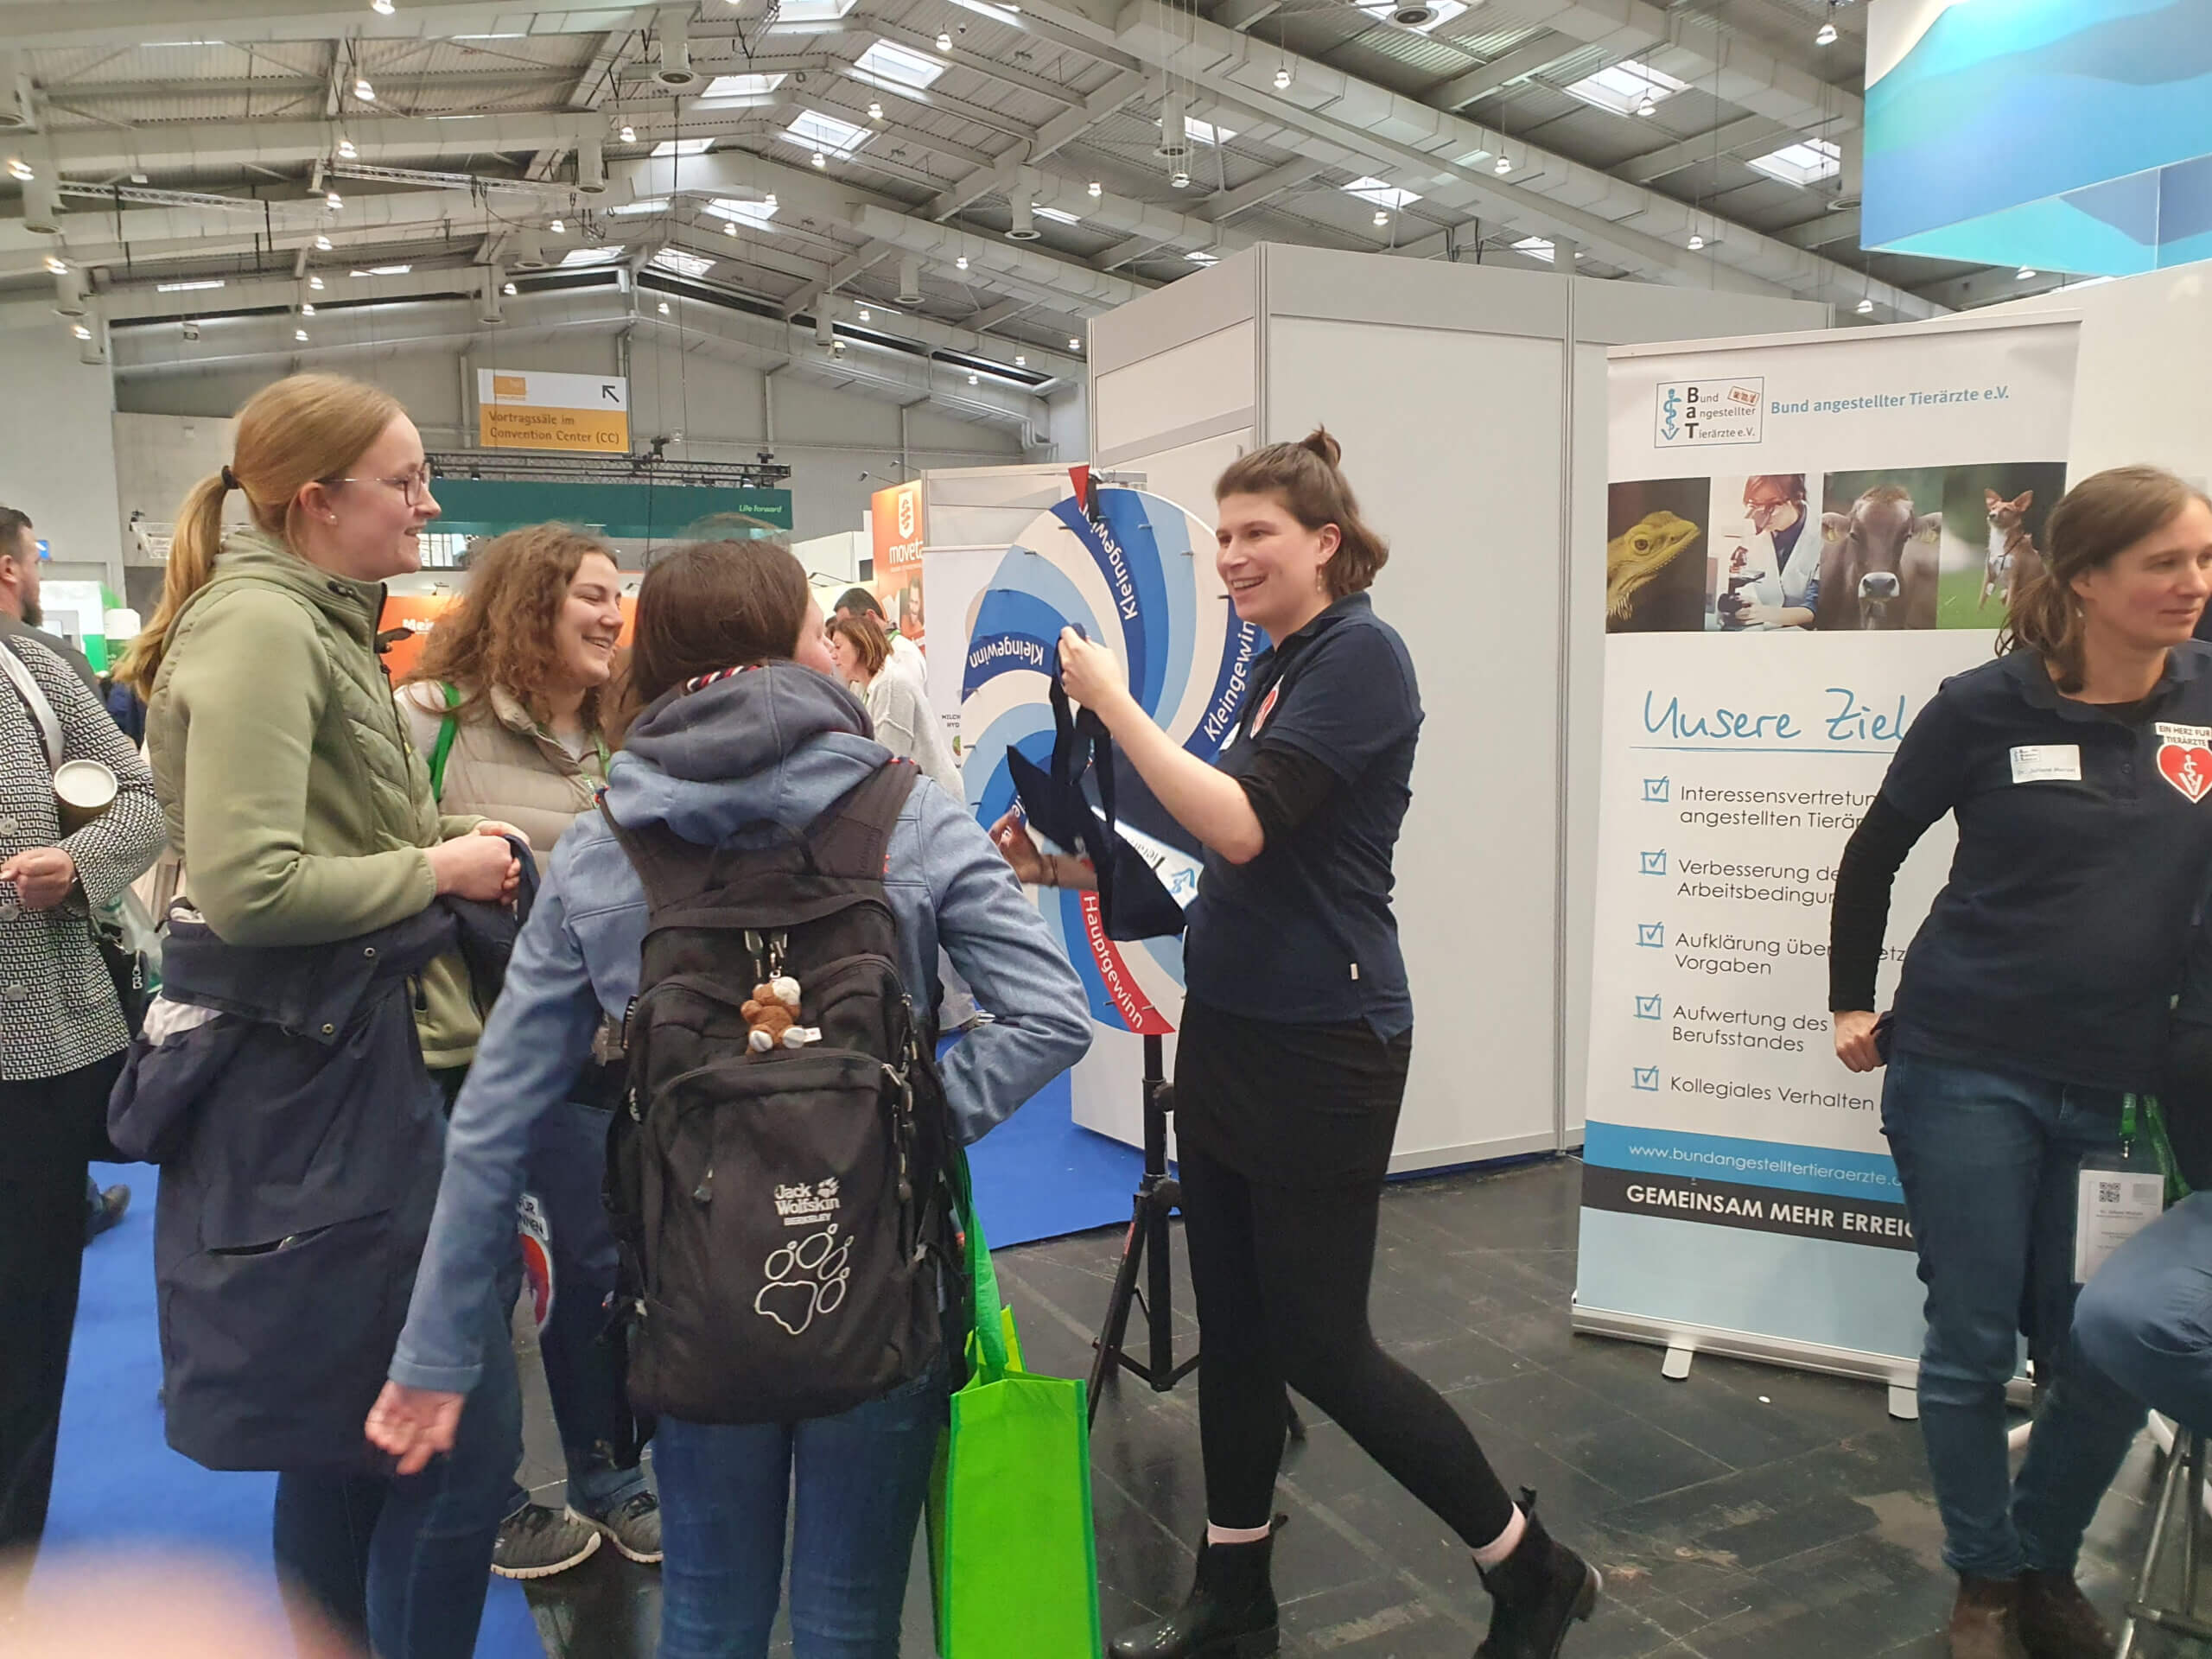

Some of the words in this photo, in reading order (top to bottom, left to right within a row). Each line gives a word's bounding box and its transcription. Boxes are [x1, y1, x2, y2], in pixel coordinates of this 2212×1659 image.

[1688, 387, 1719, 404] Bund
[1770, 399, 1809, 415] Bund
[1814, 393, 1906, 413] angestellter
[1909, 388, 1980, 406] Tierärzte
[1984, 386, 2010, 400] e.V.
[488, 410, 557, 426] Vortragssäle
[562, 414, 575, 425] im
[1686, 406, 1757, 420] angestellter
[490, 427, 552, 441] Convention
[556, 430, 591, 442] Center
[596, 432, 620, 445] (CC)
[1684, 423, 1736, 439] Tierärzte
[1738, 427, 1756, 437] e.V.
[888, 537, 924, 565] movet
[969, 636, 1044, 668] Kleingewinn
[1204, 620, 1256, 742] Kleingewin
[1643, 690, 1802, 740] Unsere
[1825, 688, 1905, 741] Ziel
[1680, 809, 1801, 829] angestellten
[1678, 860, 1809, 883] Verbesserung
[1675, 932, 1781, 957] Aufklärung
[1084, 895, 1144, 1028] Hauptgewinn
[1675, 954, 1772, 976] Vorgaben
[1673, 1004, 1786, 1031] Aufwertung
[1792, 1014, 1827, 1032] des
[1672, 1027, 1804, 1052] Berufsstandes
[1670, 1076, 1771, 1100] Kollegiales
[1777, 1087, 1874, 1111] Verhalten
[774, 1183, 812, 1200] Jack
[774, 1197, 841, 1216] Wolfskin
[1626, 1185, 1764, 1219] GEMEINSAM
[1770, 1204, 1834, 1228] MEHR
